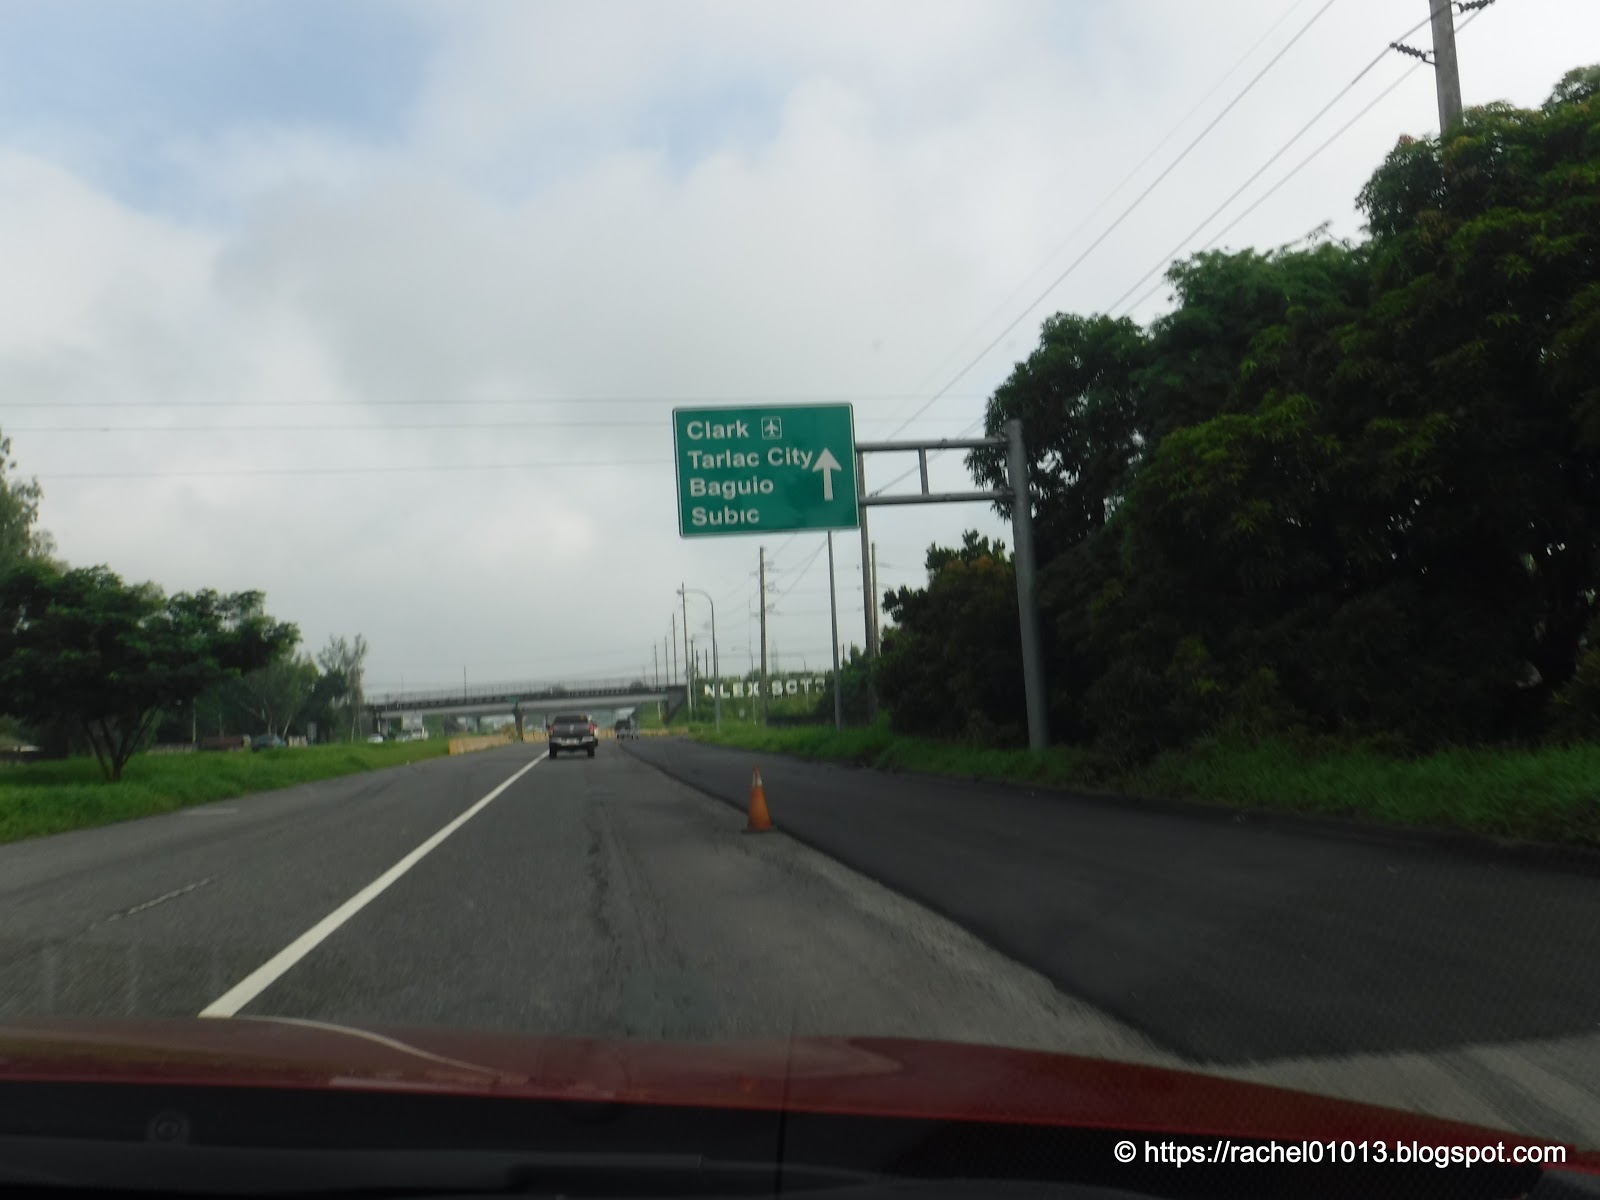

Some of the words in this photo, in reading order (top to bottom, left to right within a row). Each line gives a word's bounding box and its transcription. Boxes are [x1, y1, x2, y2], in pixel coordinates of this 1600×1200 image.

[687, 420, 749, 440] Clark
[687, 449, 760, 469] Tarlac
[767, 447, 813, 469] City
[690, 476, 774, 499] Baguio
[692, 506, 760, 526] Subic
